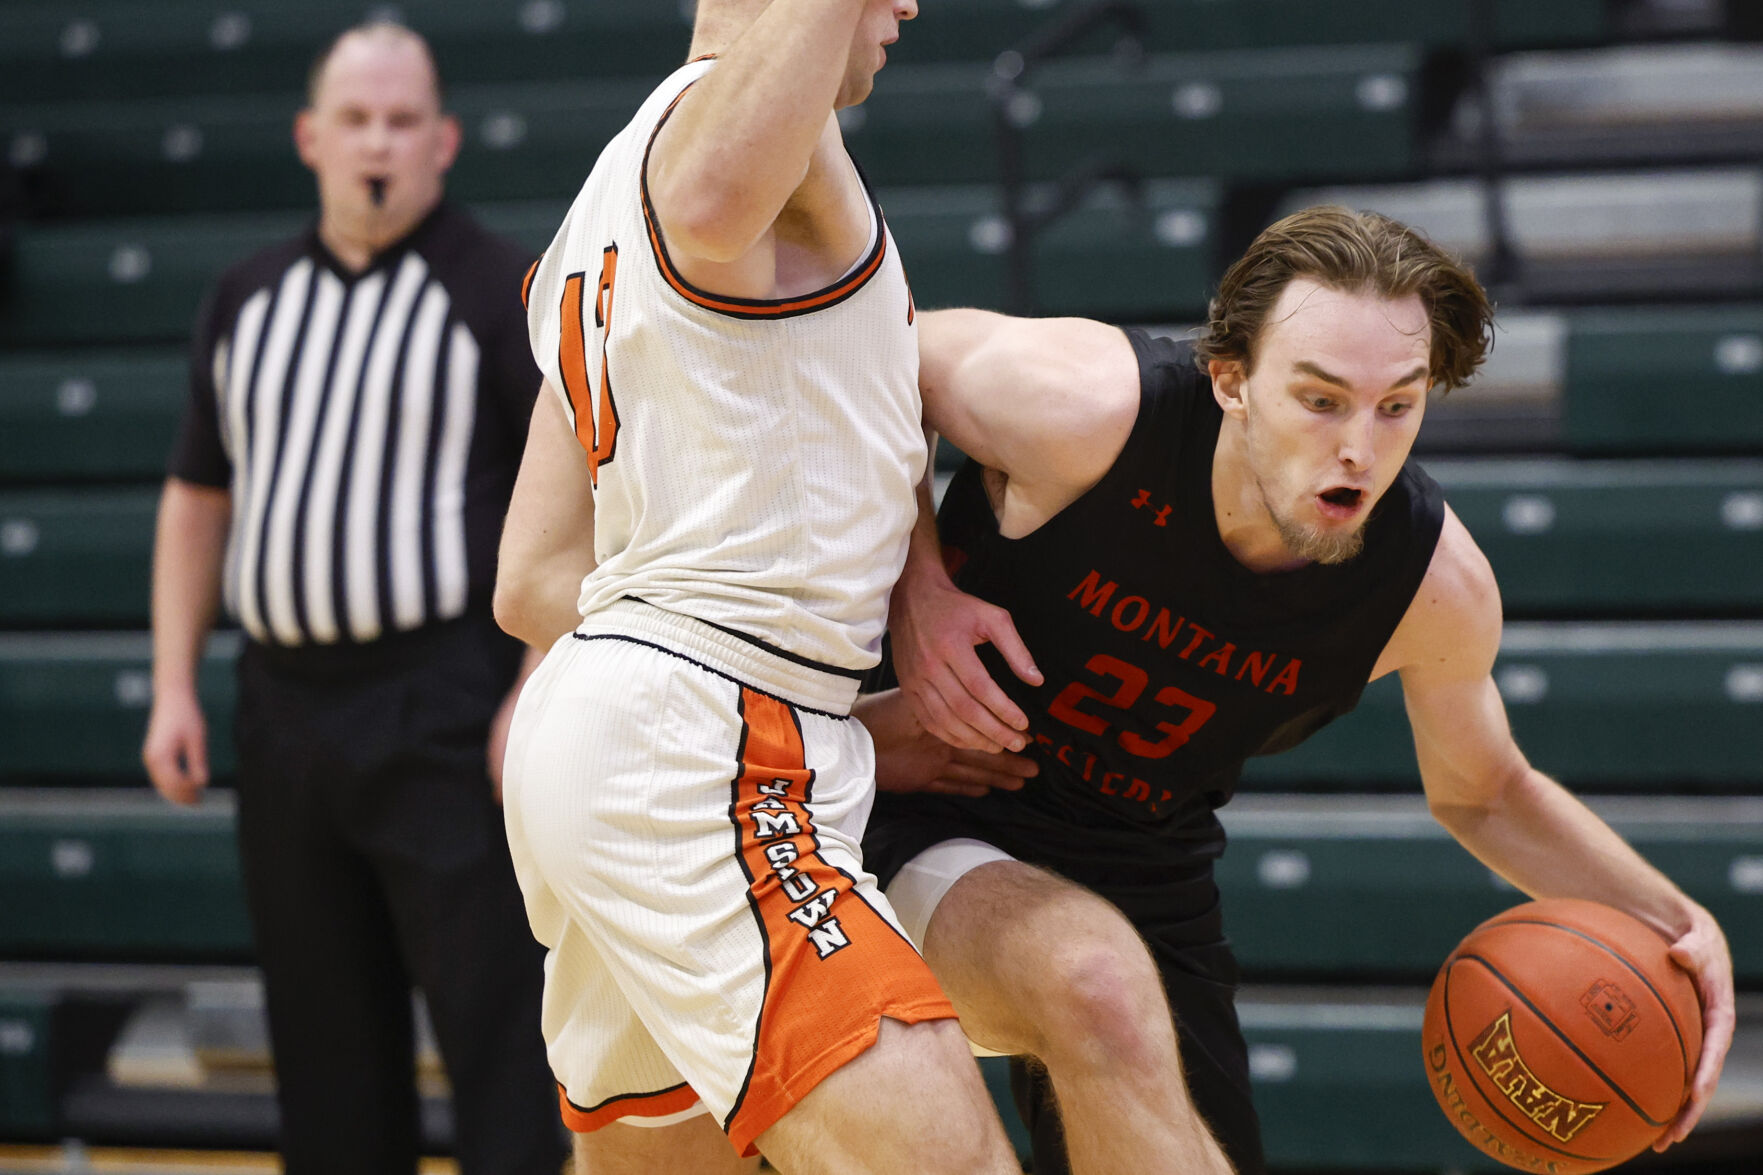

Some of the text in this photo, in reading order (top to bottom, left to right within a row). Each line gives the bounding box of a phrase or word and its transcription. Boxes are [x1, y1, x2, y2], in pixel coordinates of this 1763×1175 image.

[1067, 568, 1302, 696] MONTANA
[1047, 653, 1217, 759] 23
[1469, 1010, 1607, 1142] NAIA
